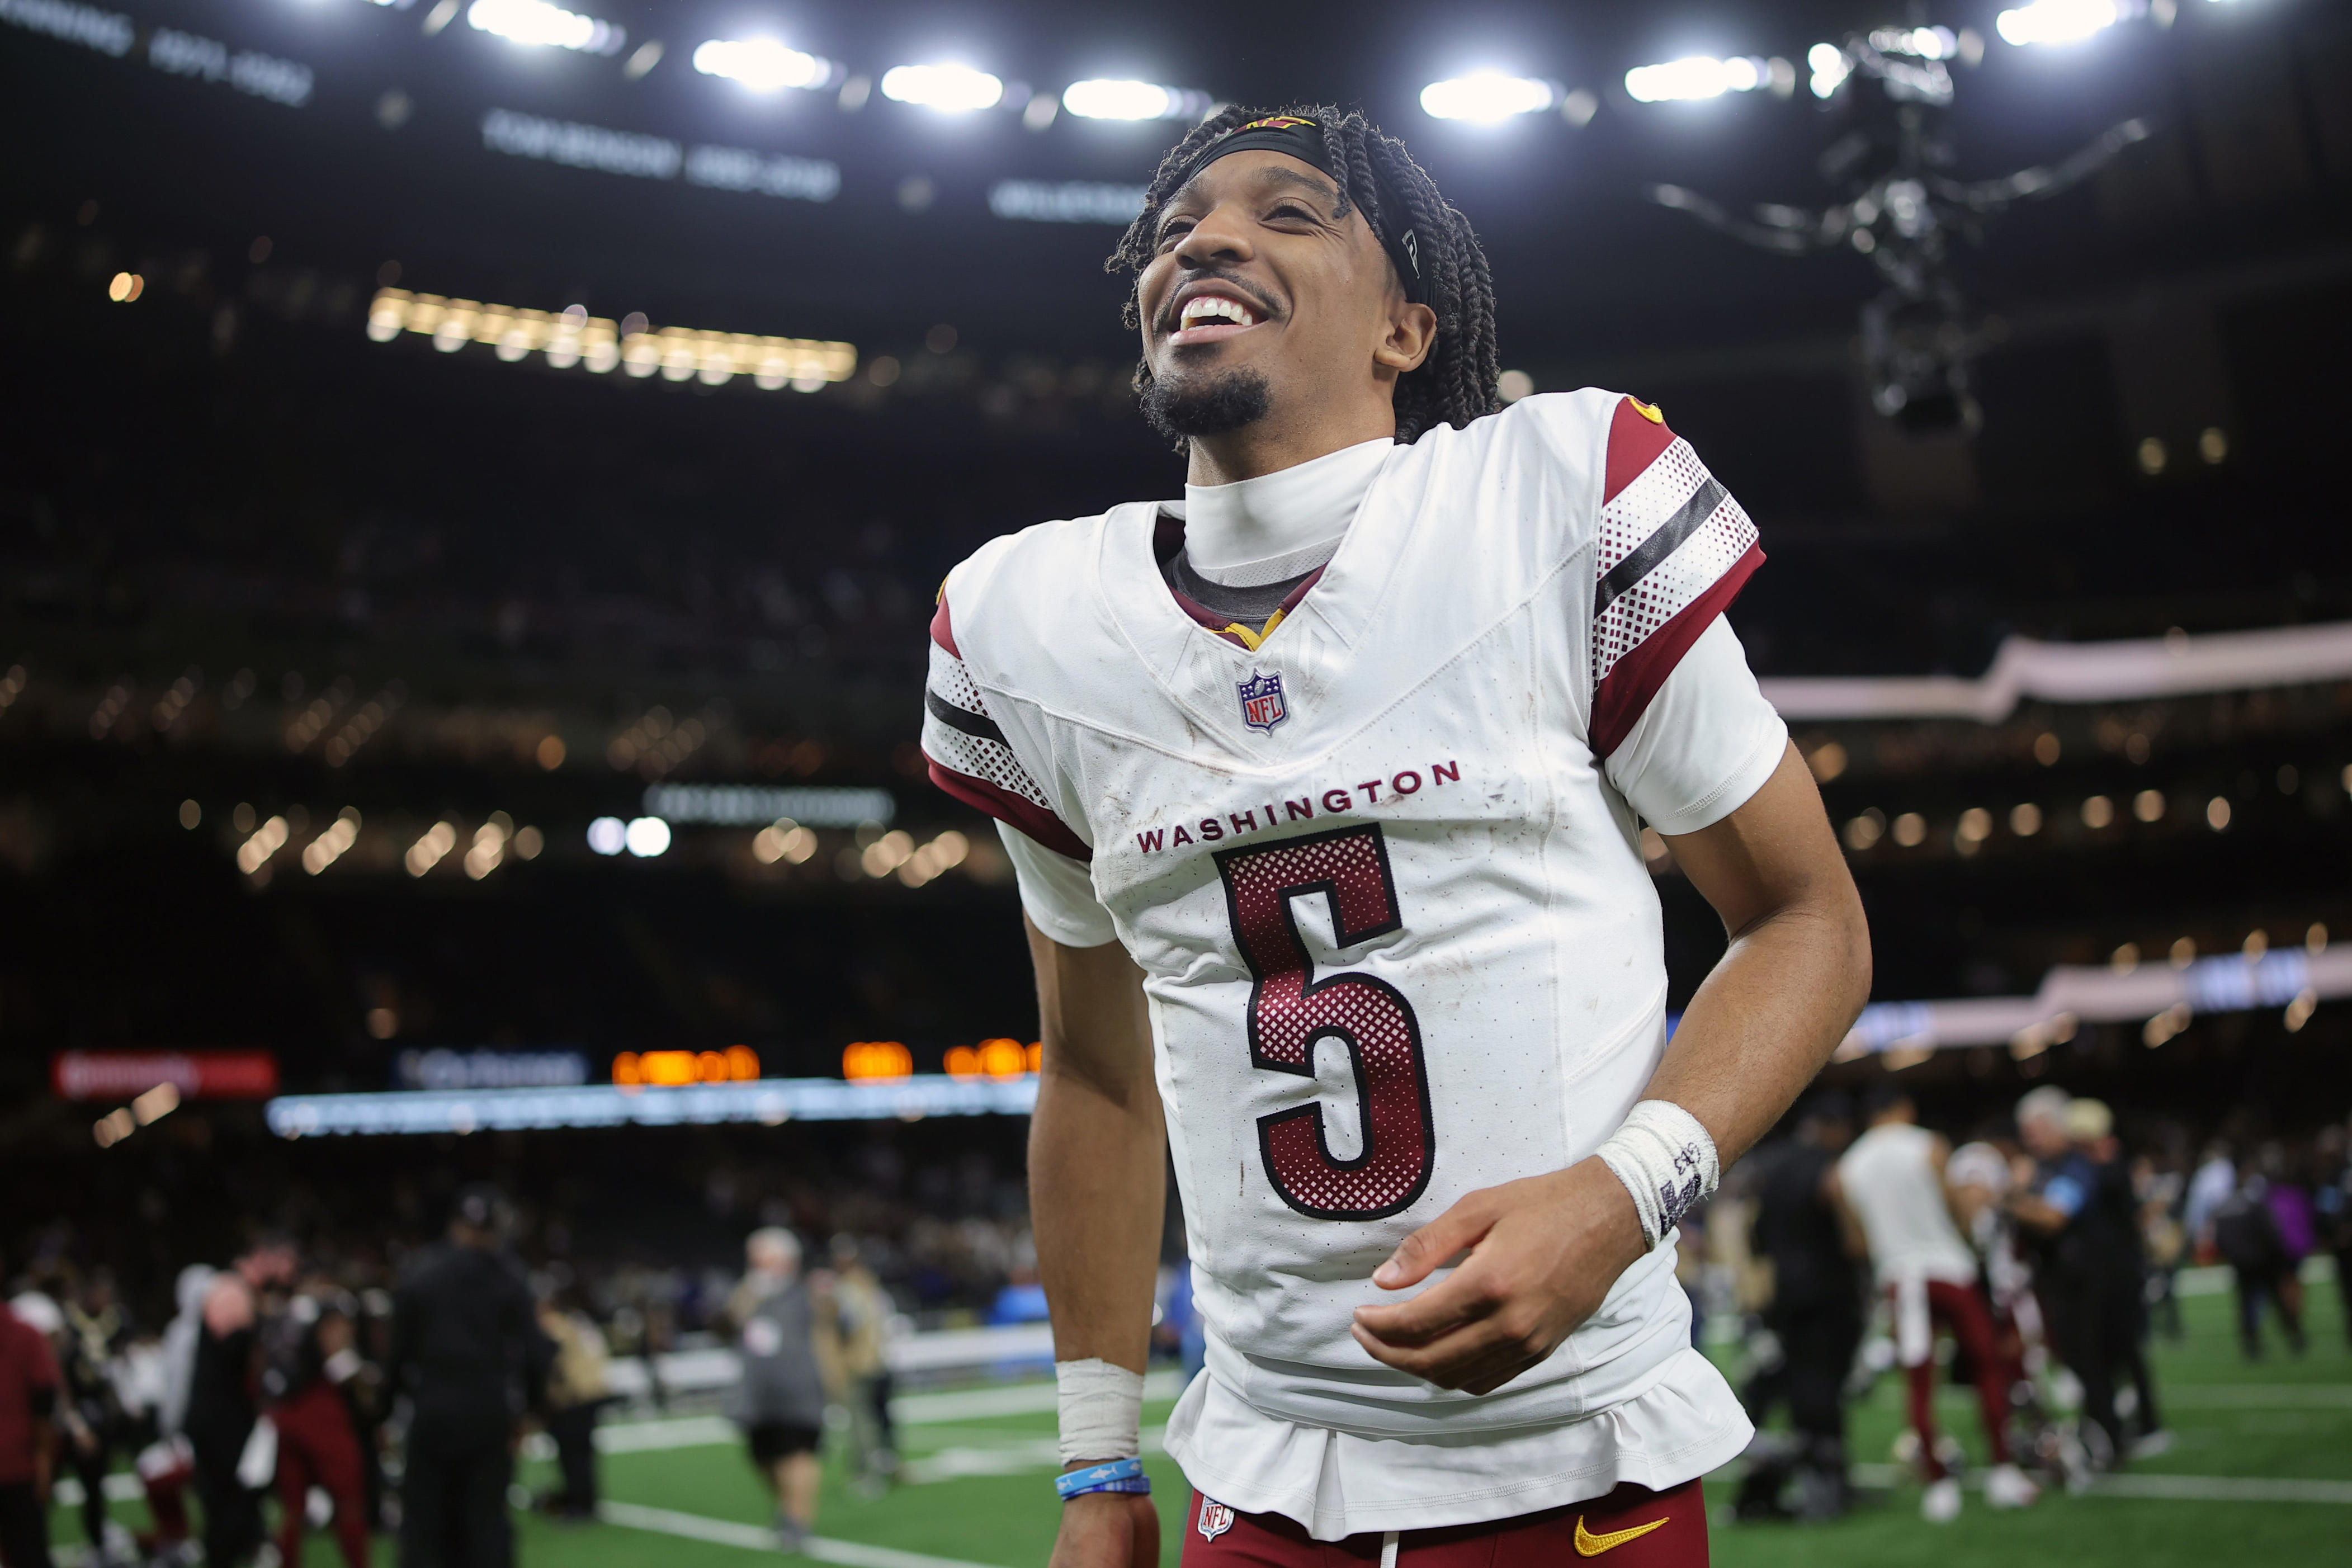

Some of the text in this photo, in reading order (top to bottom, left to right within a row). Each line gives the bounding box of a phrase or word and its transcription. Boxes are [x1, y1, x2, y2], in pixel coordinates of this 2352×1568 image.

[1246, 696, 1282, 723] NFL
[1137, 761, 1460, 853] WASHINGTON
[1211, 821, 1435, 1221] 5
[1203, 1505, 1227, 1529] NFL
